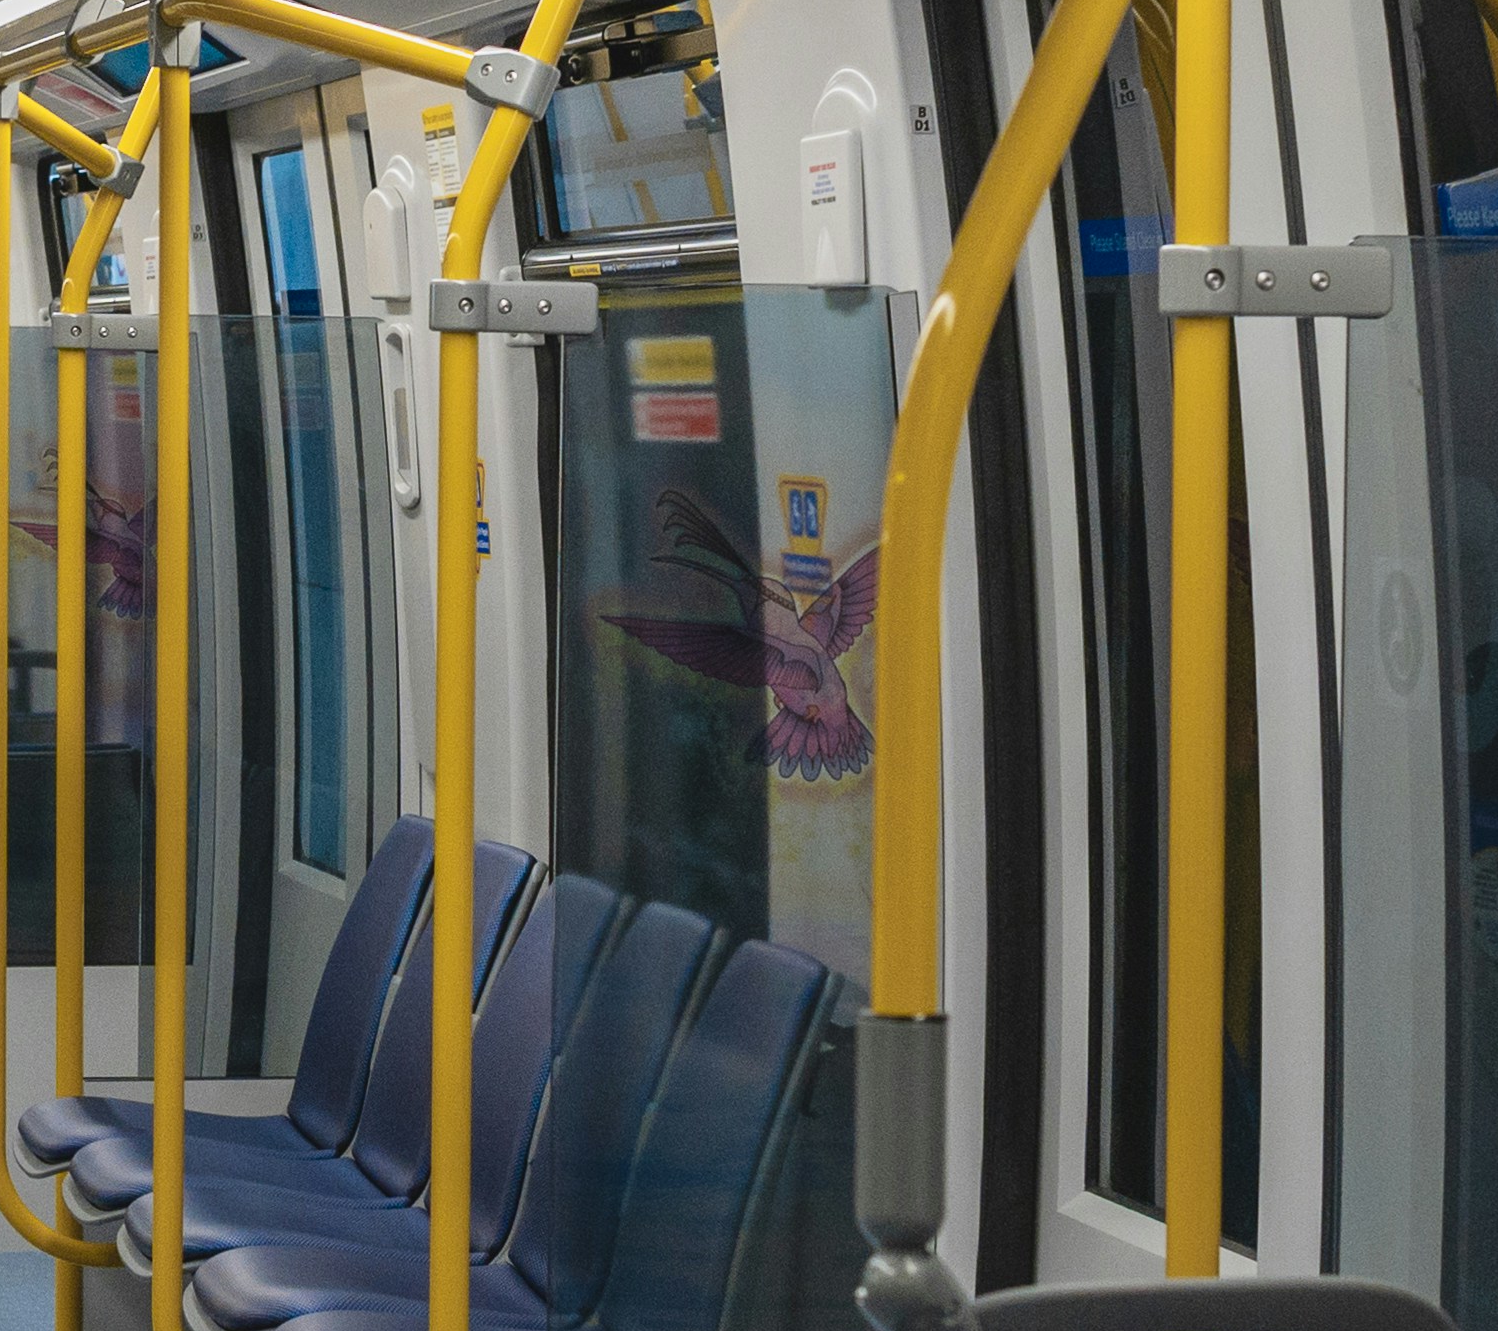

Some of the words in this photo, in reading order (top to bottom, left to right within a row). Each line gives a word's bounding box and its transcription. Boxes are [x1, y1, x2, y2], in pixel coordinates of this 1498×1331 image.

[918, 106, 927, 118] B
[915, 119, 930, 132] D1
[1448, 204, 1480, 228] Please
